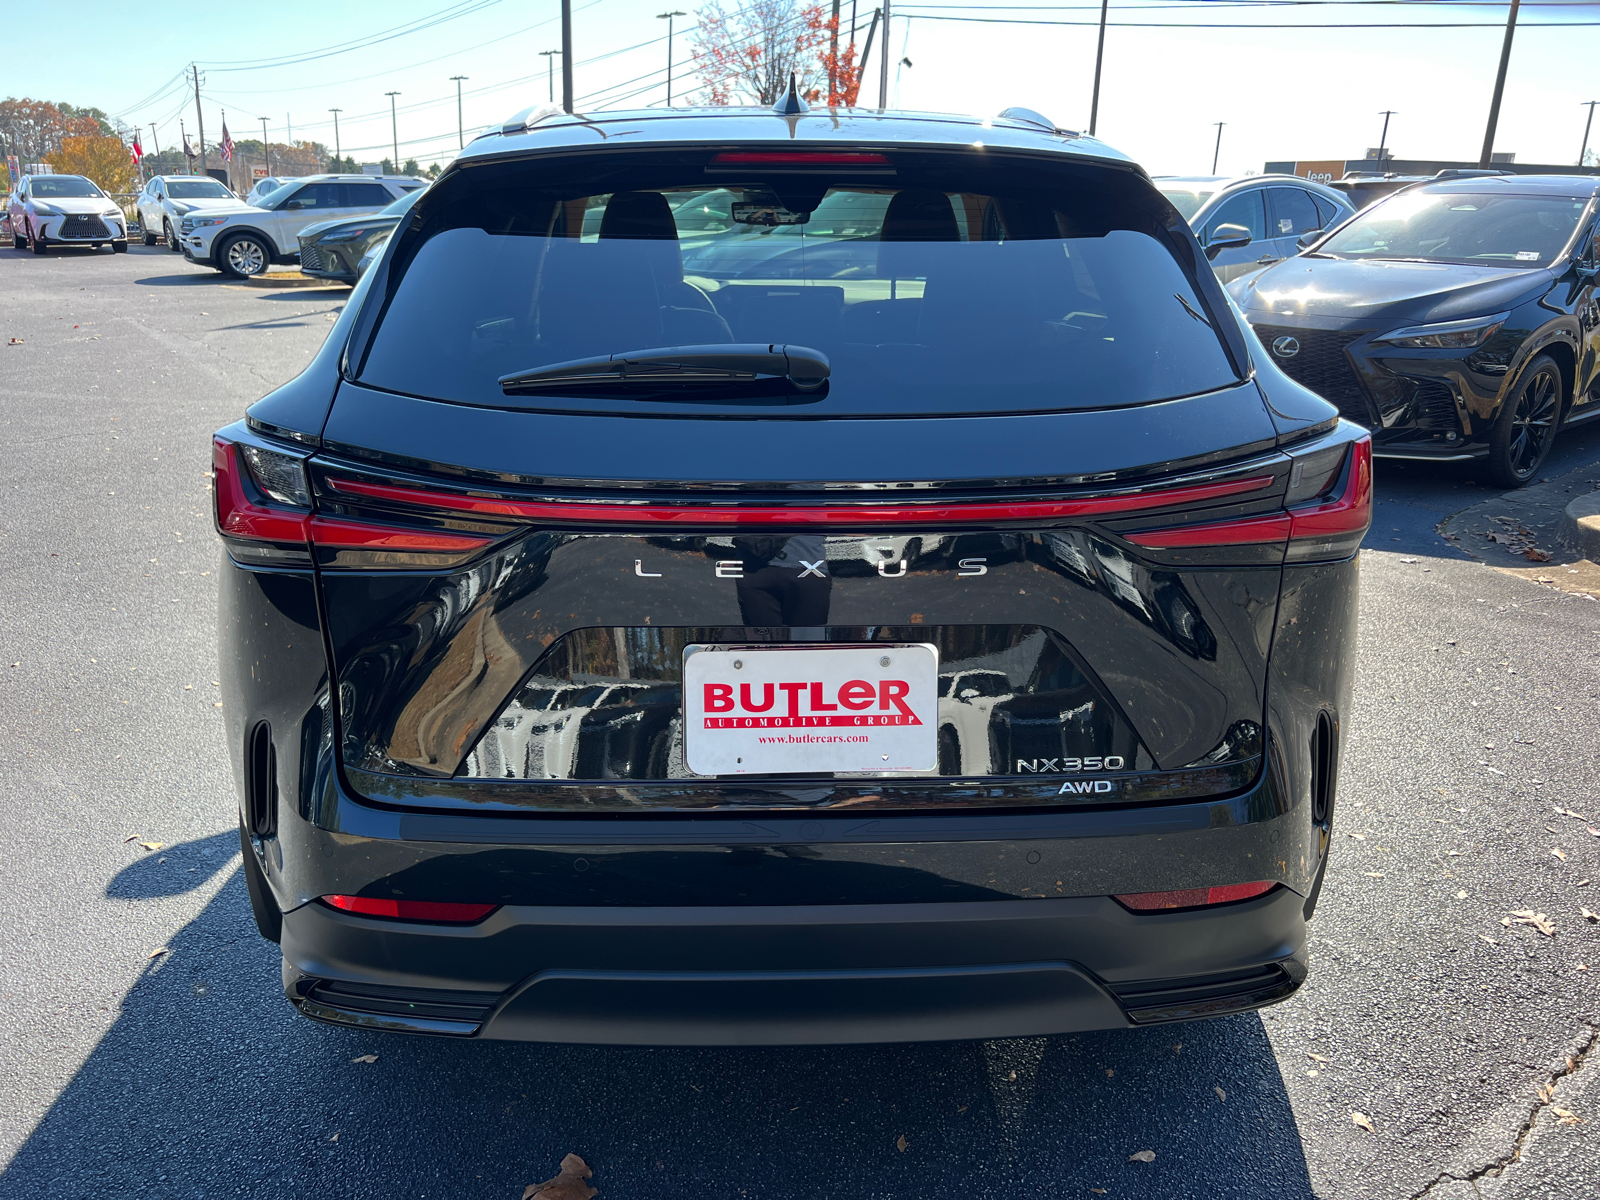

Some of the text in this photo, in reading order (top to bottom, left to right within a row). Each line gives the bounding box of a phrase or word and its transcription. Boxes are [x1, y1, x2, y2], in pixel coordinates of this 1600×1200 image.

[1306, 170, 1332, 184] Jeep
[634, 558, 988, 579] LEXUS
[705, 715, 915, 728] AUTOMOTIVE GROUP
[758, 734, 869, 744] www.butlercars.com
[1058, 780, 1112, 795] AWD
